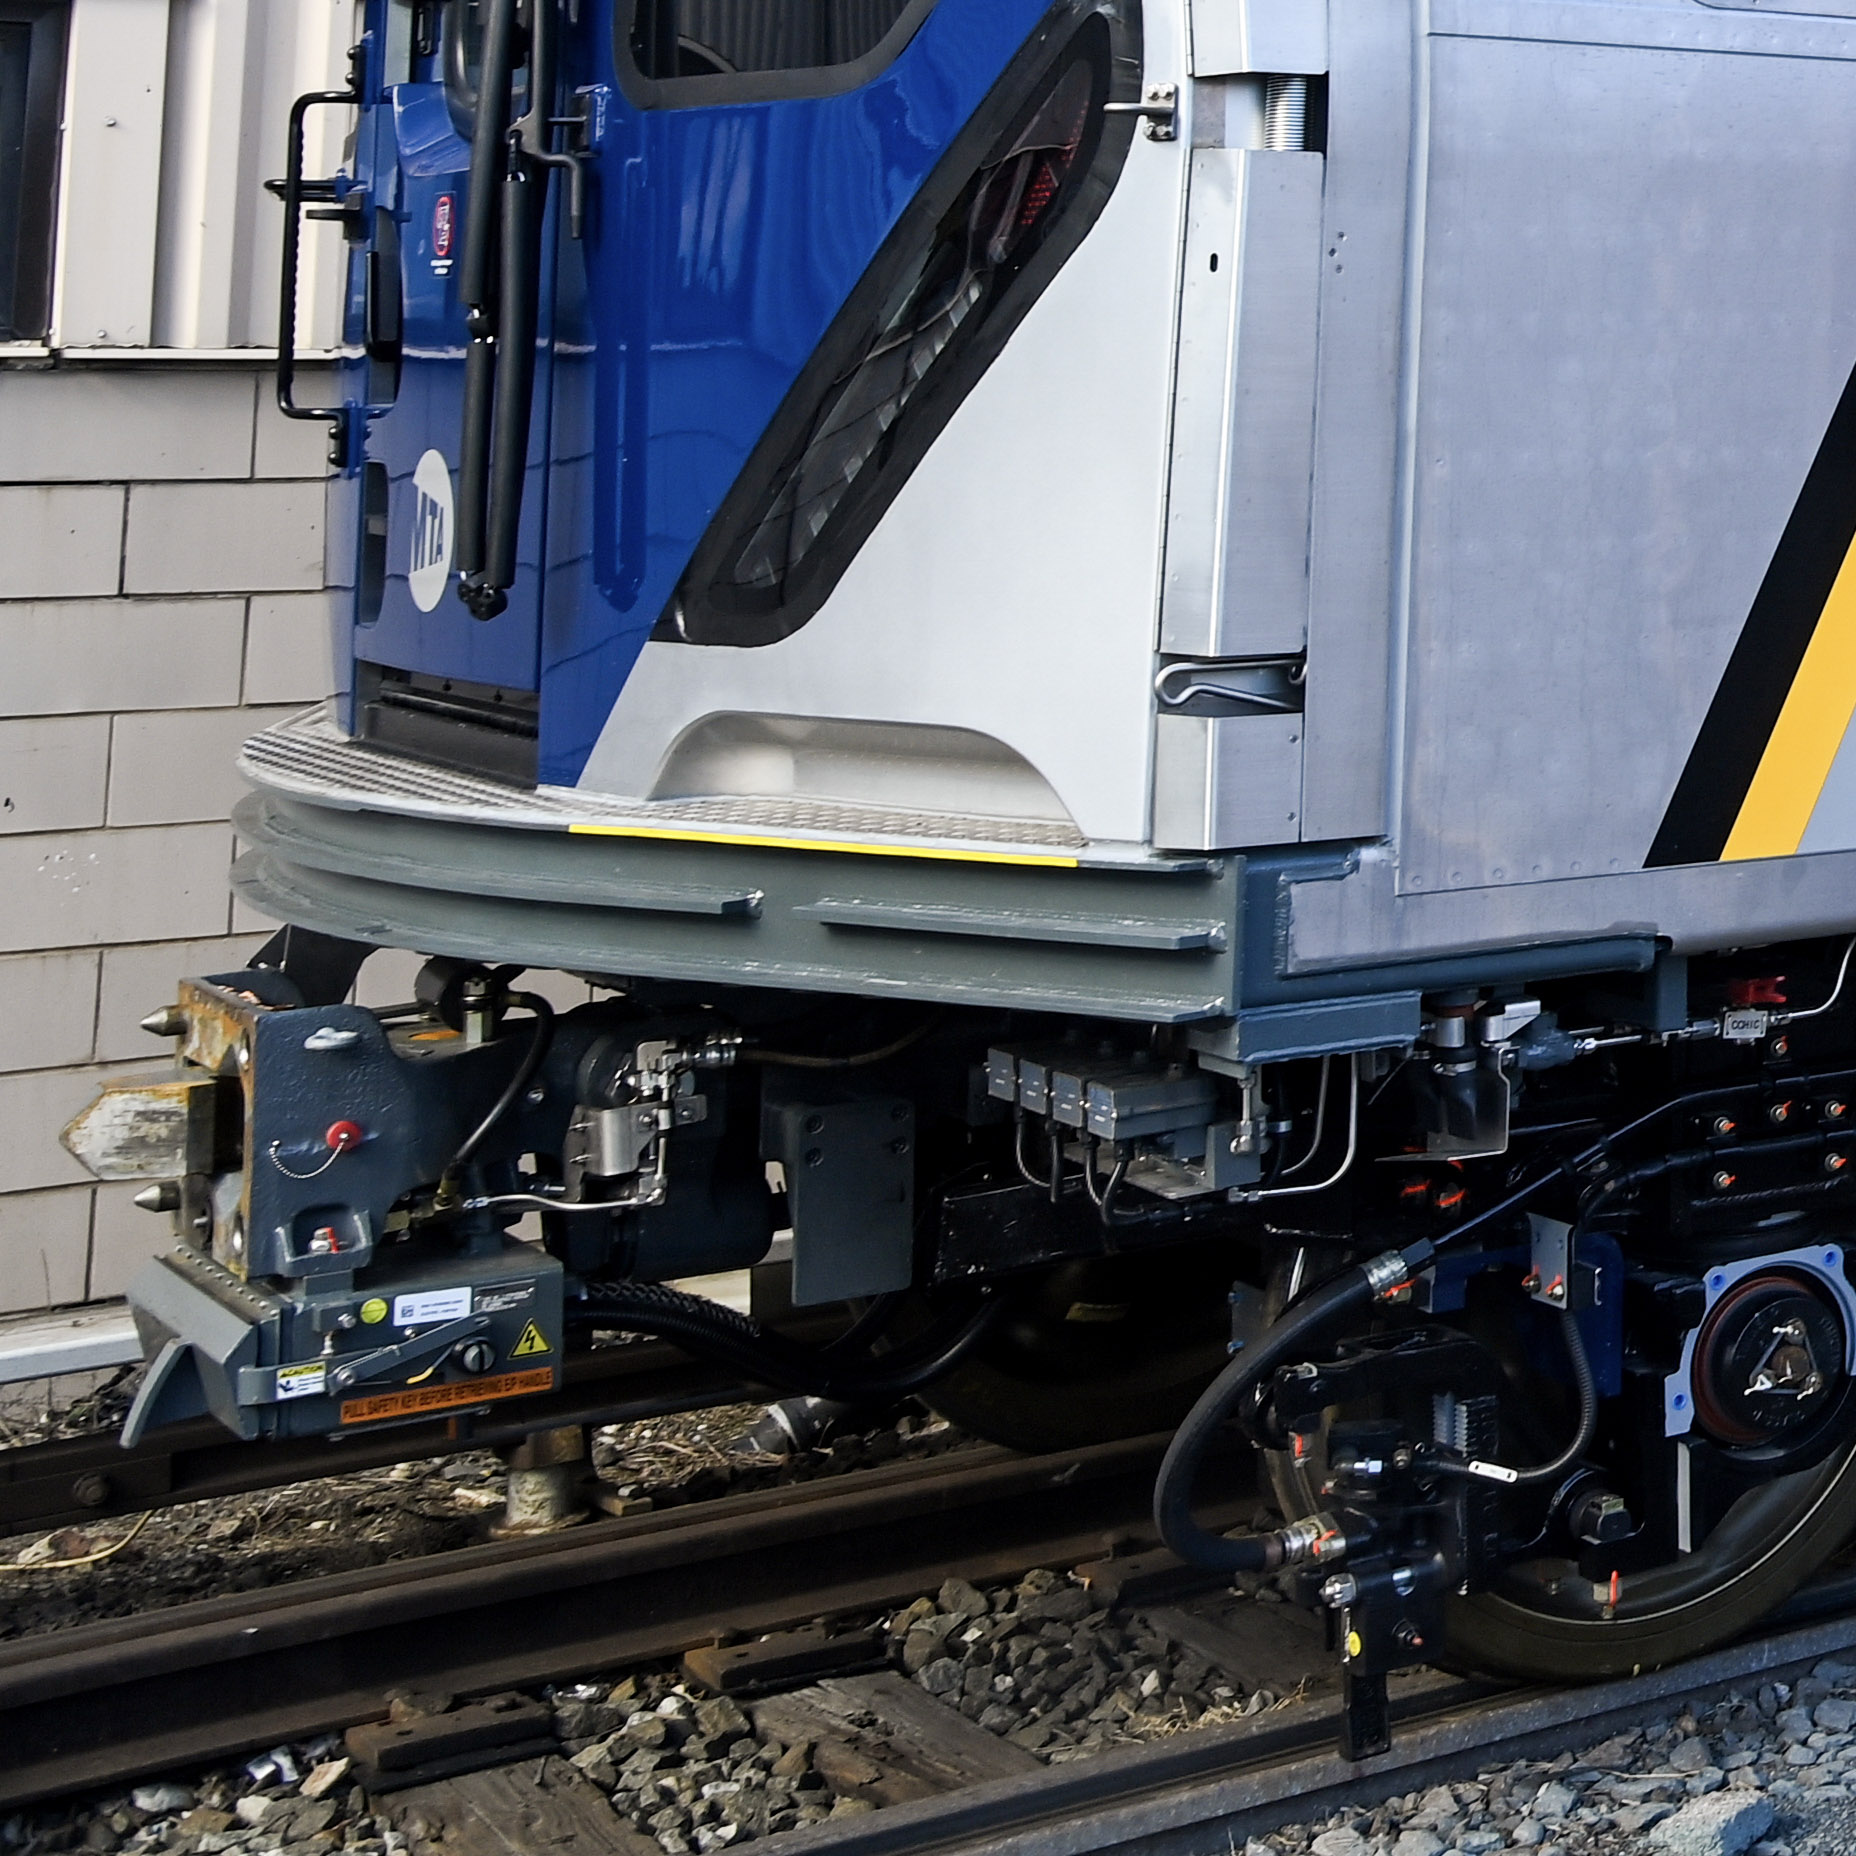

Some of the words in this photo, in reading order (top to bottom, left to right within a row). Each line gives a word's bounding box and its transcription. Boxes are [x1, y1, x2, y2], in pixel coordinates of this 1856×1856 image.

[410, 484, 445, 573] MTA
[367, 1397, 399, 1415] SAFETY
[419, 1389, 452, 1407] BEFORE
